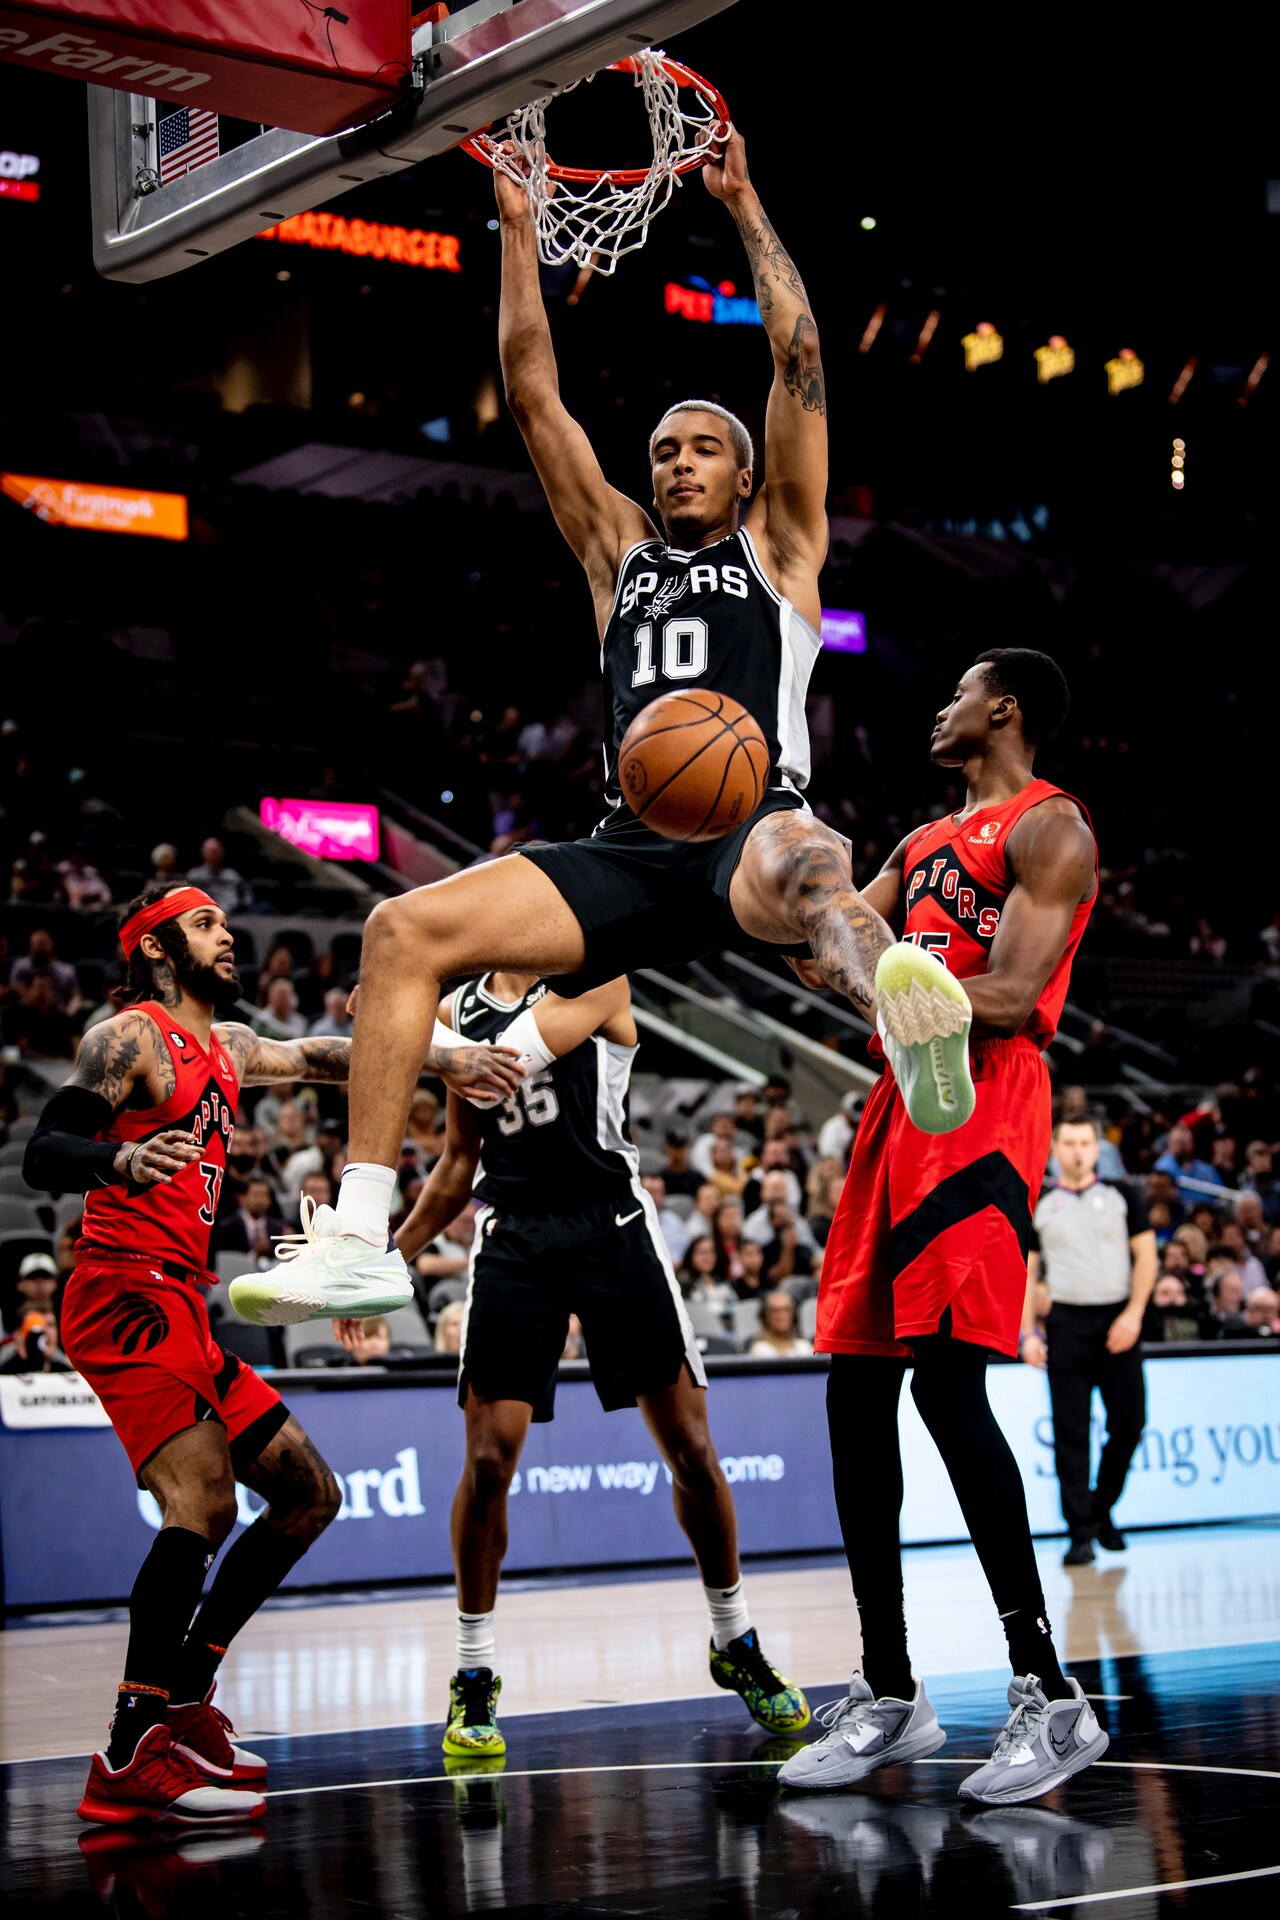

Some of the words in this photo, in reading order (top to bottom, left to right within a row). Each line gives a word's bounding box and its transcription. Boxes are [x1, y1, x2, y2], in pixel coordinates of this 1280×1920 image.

[254, 209, 462, 273] HATABURGER
[619, 564, 749, 620] SPURS
[631, 616, 709, 689] 10
[968, 836, 983, 844] Sun
[906, 859, 1000, 938] PTORS
[463, 995, 476, 1009] 6
[170, 1033, 185, 1048] 6
[497, 1067, 560, 1137] 35
[198, 1161, 224, 1226] 3
[527, 1465, 592, 1494] new
[596, 1461, 659, 1495] way
[718, 1454, 785, 1484] ome
